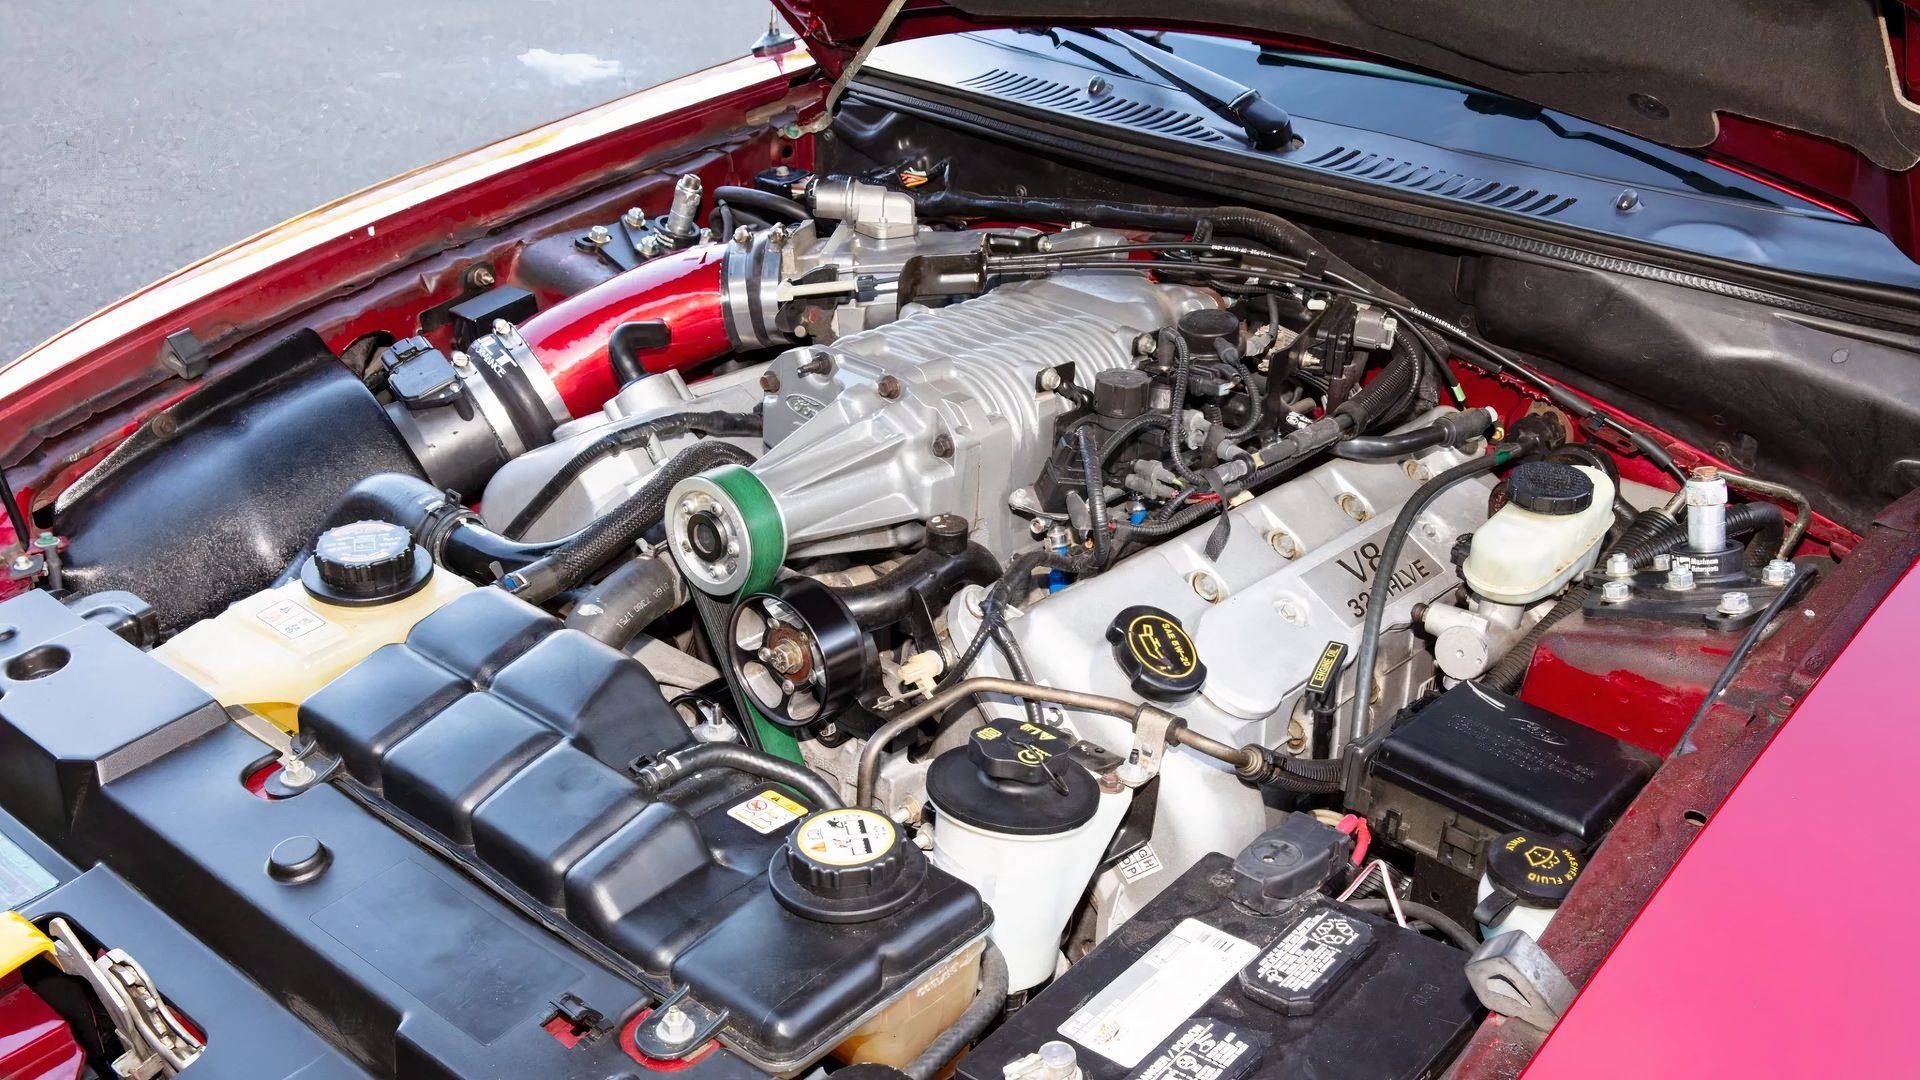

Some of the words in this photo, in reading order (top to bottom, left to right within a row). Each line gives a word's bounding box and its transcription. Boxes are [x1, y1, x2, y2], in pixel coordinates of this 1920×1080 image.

[1336, 542, 1381, 583] V8
[1382, 559, 1430, 597] ALVE
[1162, 623, 1176, 640] SAE
[1314, 656, 1334, 681] ENGINE
[1505, 836, 1527, 852] ONLY
[1562, 849, 1579, 880] WASHER
[1528, 872, 1563, 885] FLUID
